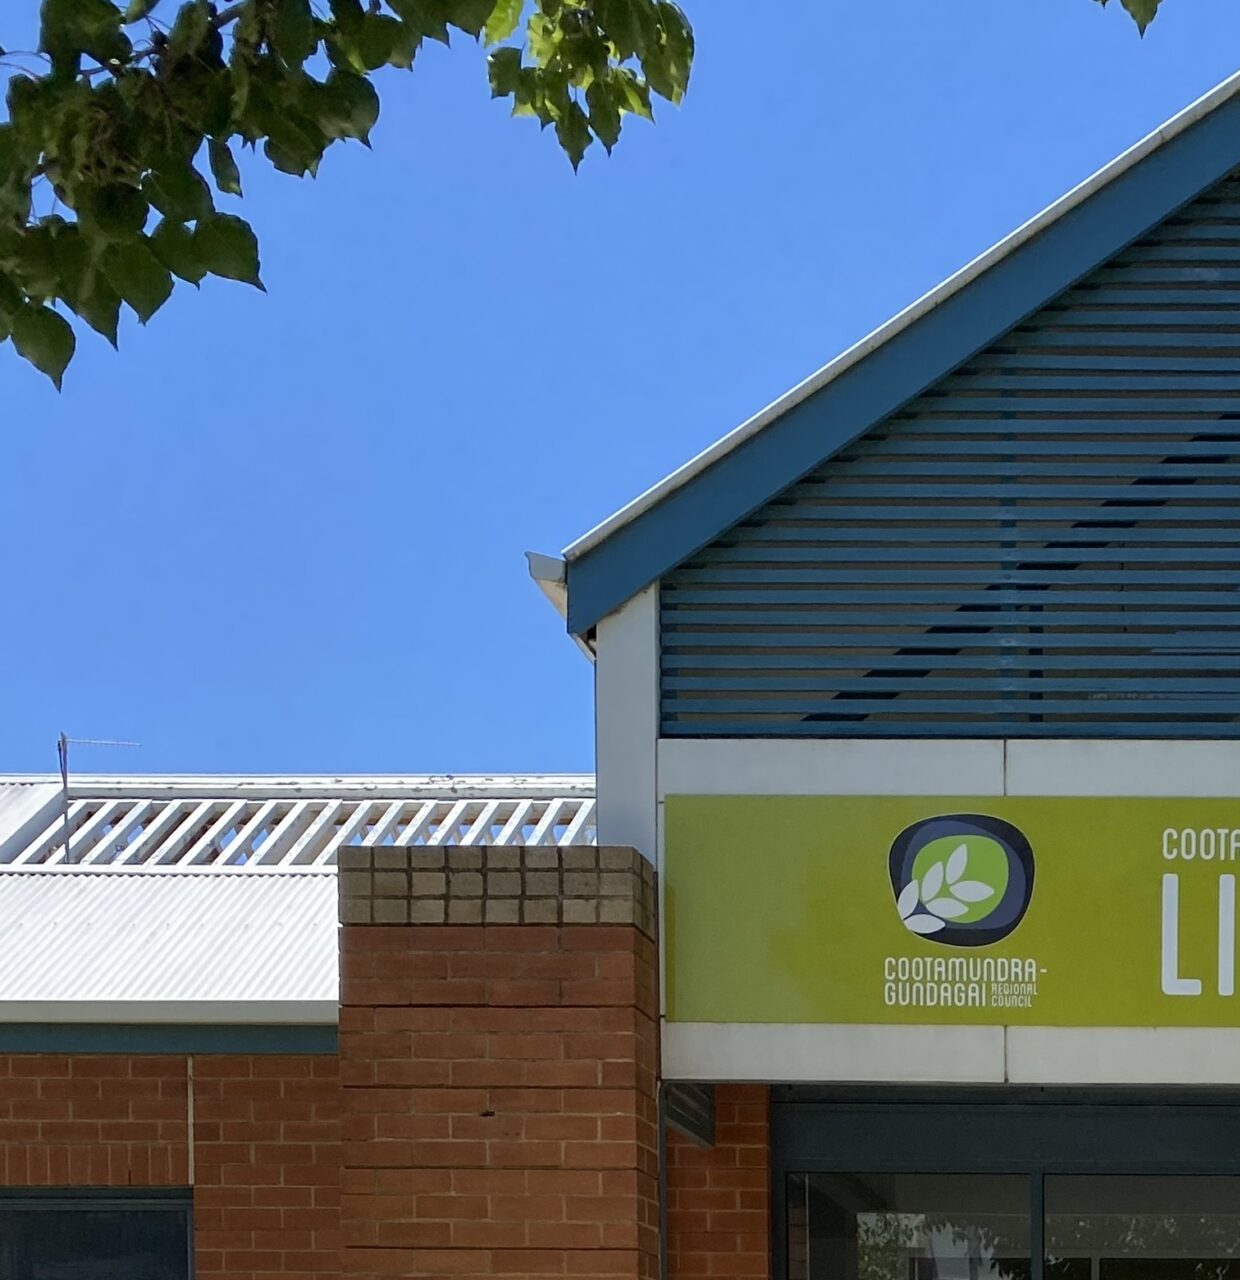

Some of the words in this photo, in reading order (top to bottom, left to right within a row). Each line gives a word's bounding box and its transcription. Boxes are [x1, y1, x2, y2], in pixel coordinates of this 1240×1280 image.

[884, 957, 1048, 982] COOTAMUNDRA-
[884, 982, 986, 1007] GUNDAGAI
[991, 983, 1038, 995] REGIONAL
[991, 995, 1033, 1007] COUNCIL
